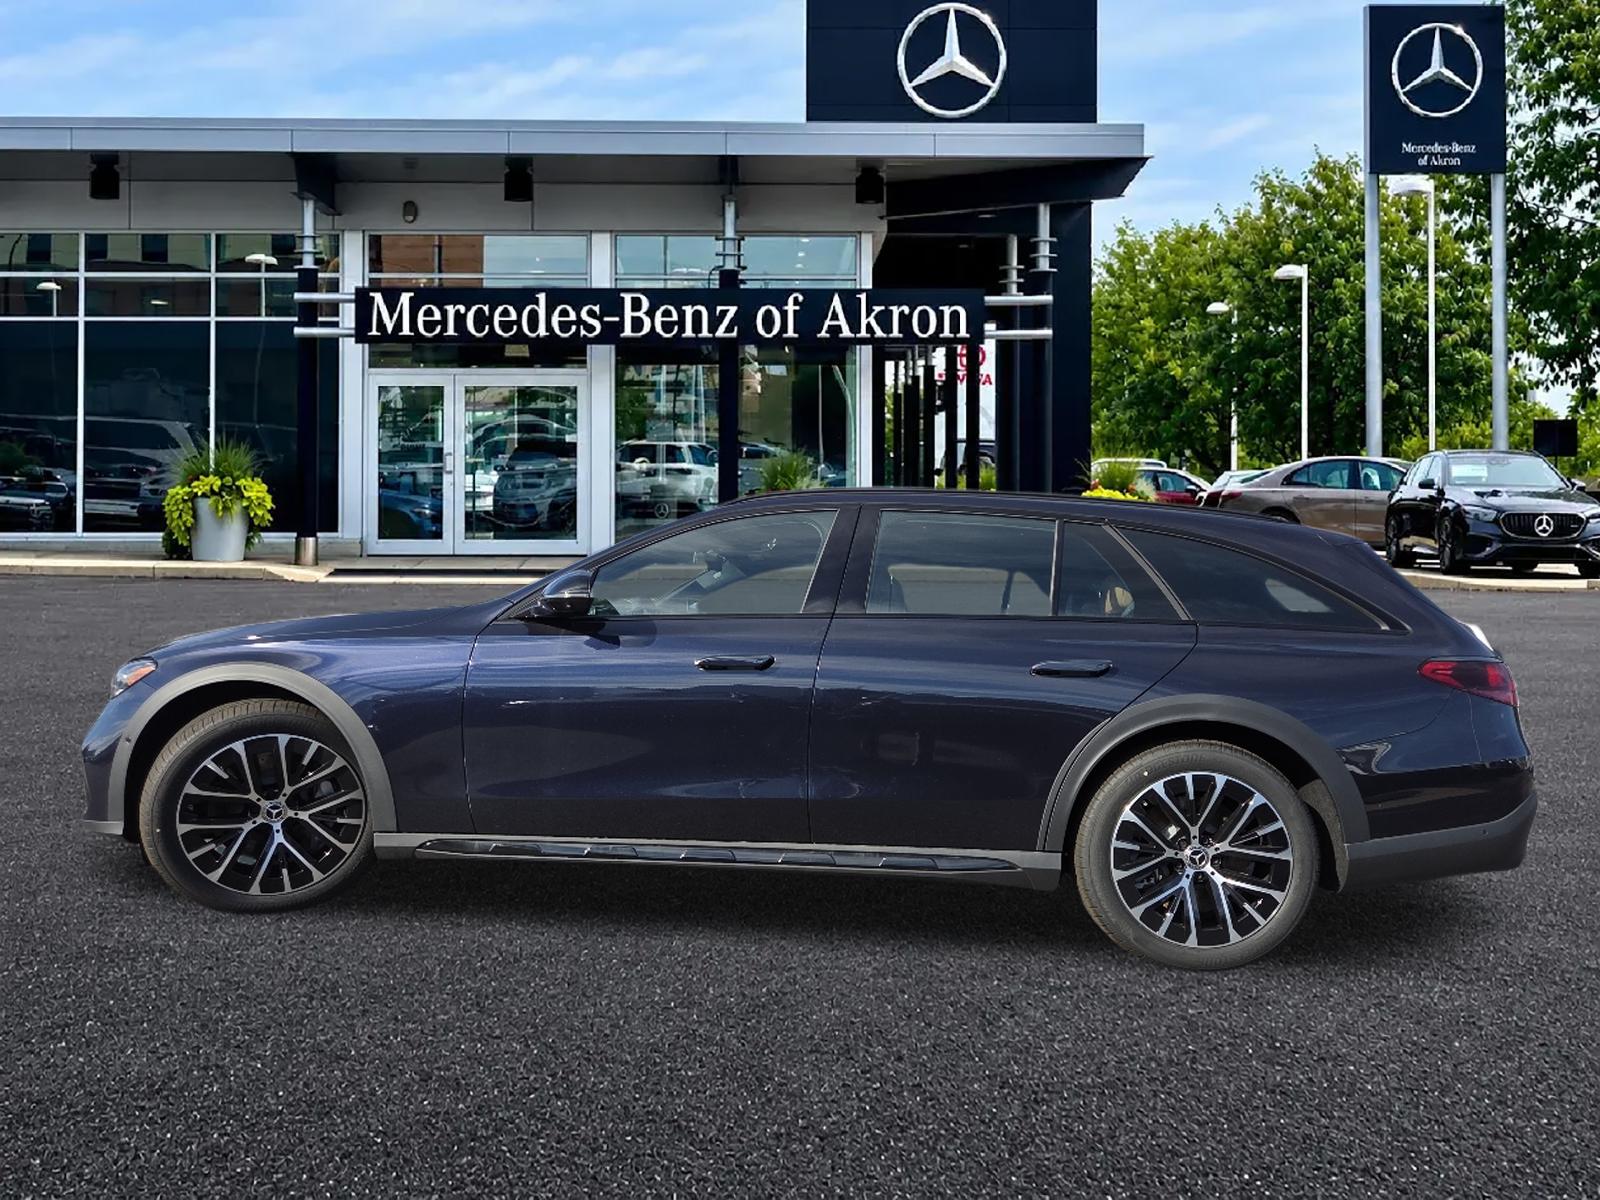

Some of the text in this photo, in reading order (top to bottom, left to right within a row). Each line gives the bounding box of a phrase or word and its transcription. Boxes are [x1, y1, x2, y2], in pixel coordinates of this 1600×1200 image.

[1401, 142, 1476, 153] Mercedes-Benz
[1417, 155, 1461, 166] of Akron
[367, 292, 970, 338] Mercedes-Benz of Akron
